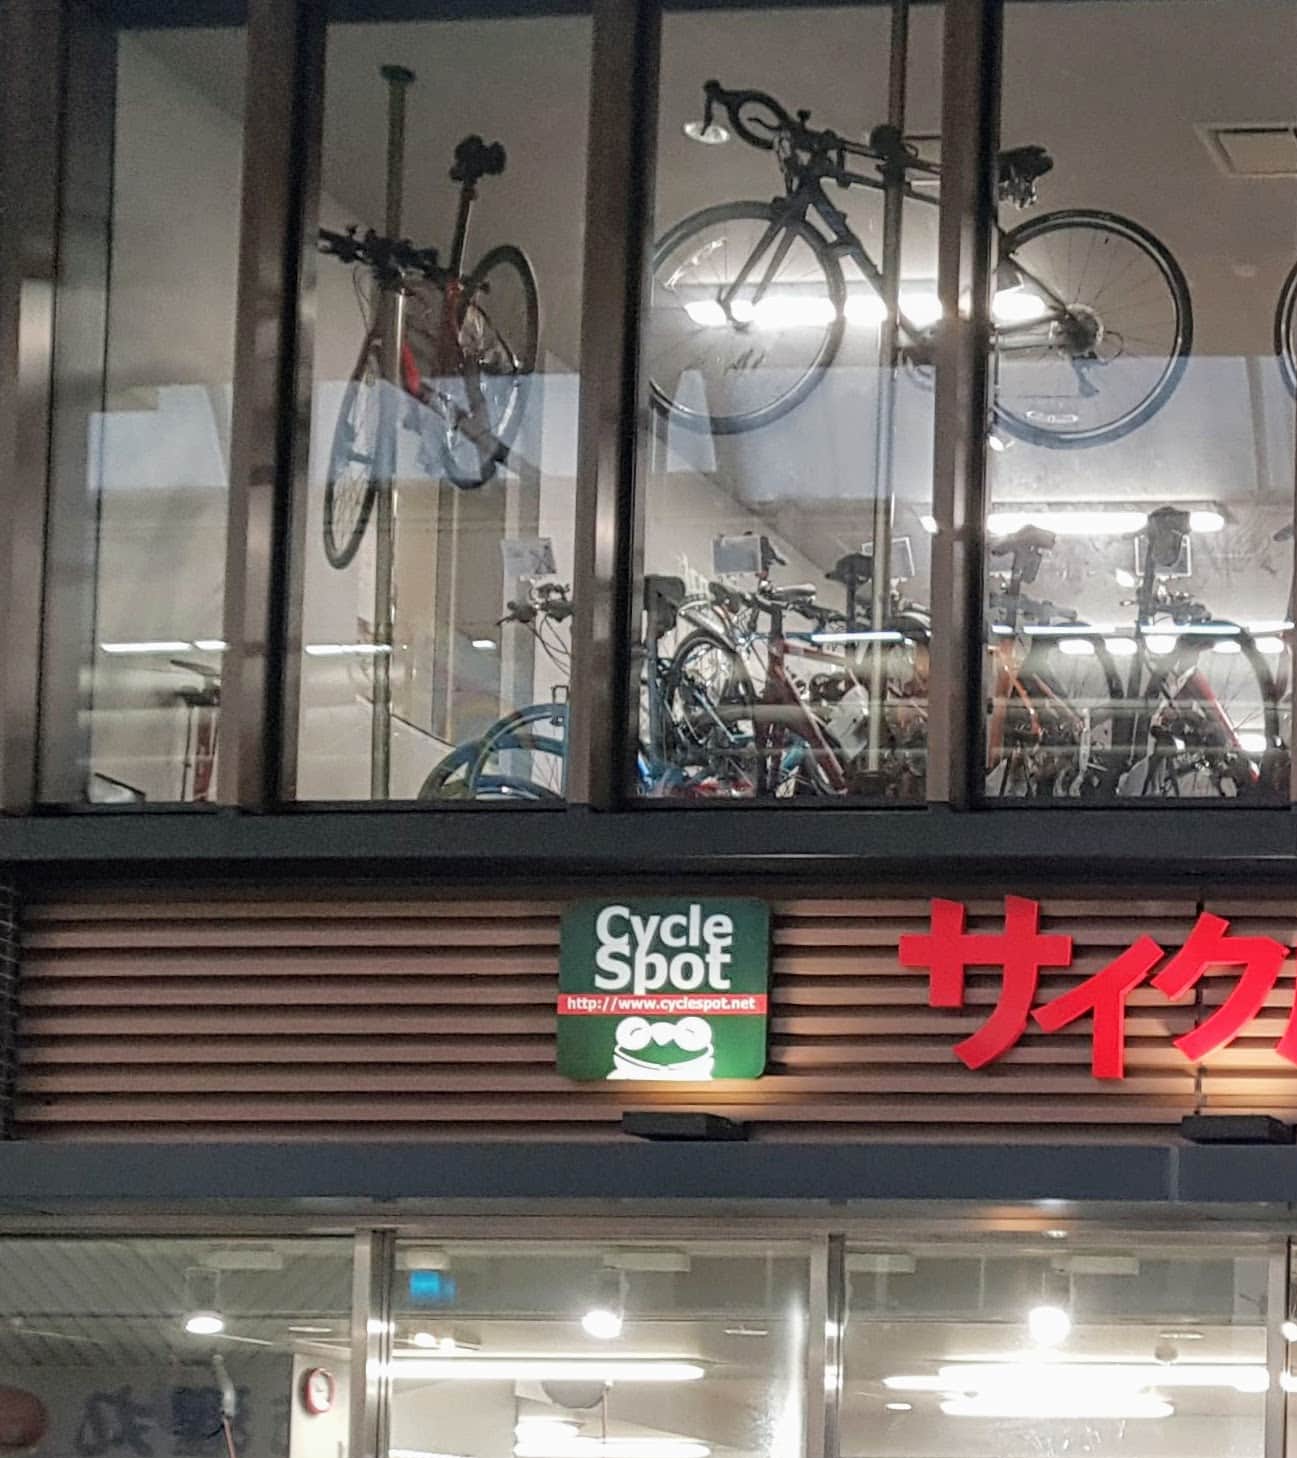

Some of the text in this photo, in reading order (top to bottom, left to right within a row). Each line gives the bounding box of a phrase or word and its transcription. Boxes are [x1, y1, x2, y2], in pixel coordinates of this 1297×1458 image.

[595, 904, 734, 949] Cycle
[594, 944, 732, 996] Spot
[567, 997, 756, 1011] http://www.cyclespot.net
